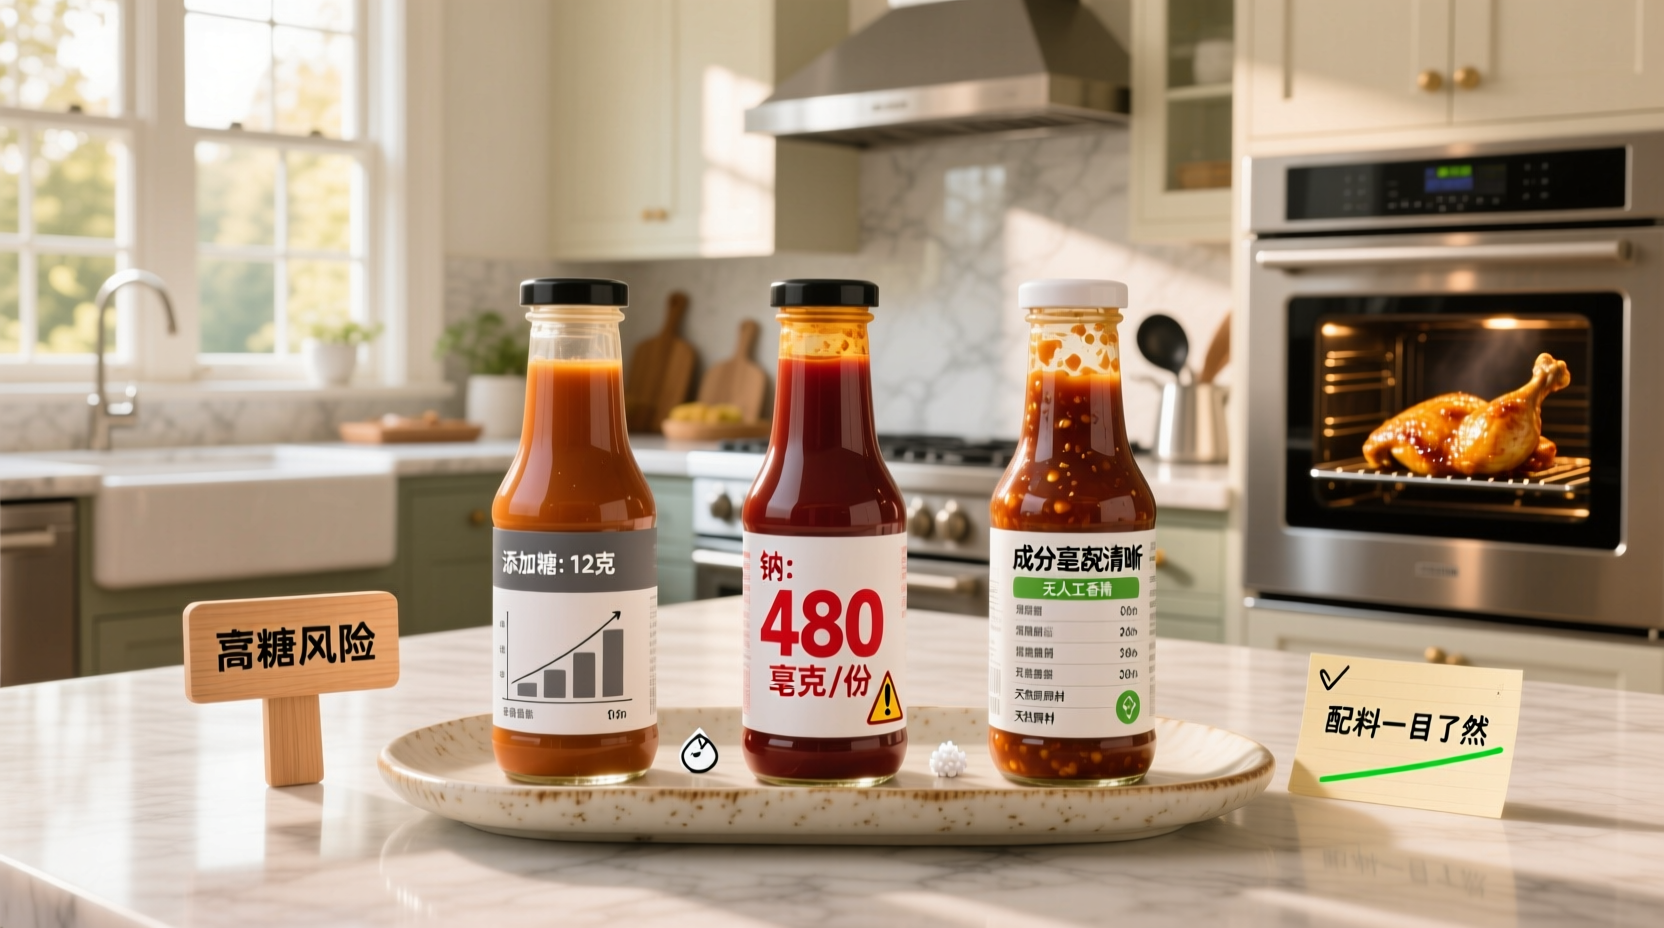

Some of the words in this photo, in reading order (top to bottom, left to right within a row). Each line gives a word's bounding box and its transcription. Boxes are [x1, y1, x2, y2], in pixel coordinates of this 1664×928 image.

[216, 621, 376, 672] 高糖风险
[760, 588, 884, 659] 480
[1325, 705, 1489, 746] 配料一目了然
